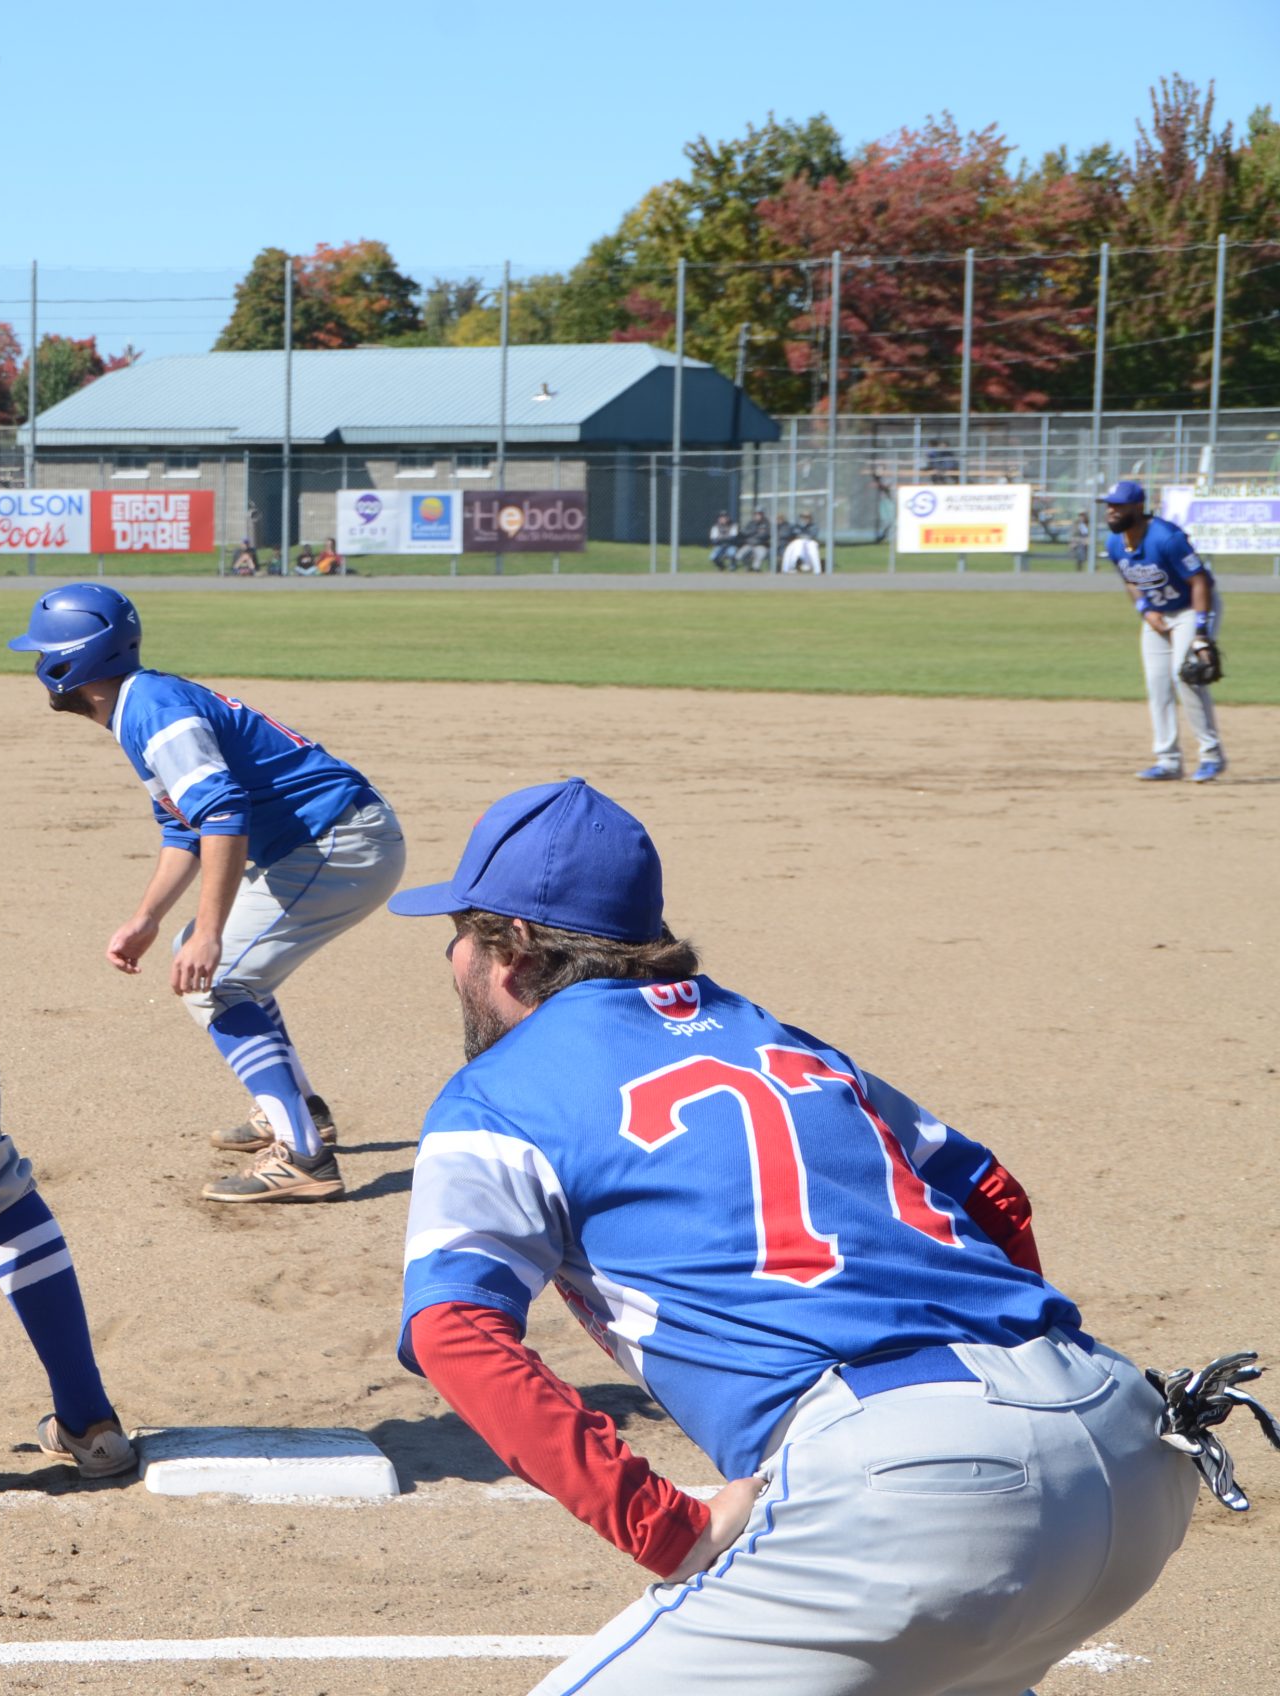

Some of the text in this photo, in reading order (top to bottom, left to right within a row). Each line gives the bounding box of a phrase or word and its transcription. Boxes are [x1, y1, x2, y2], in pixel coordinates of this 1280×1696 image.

[113, 521, 190, 549] DIABLE
[1147, 585, 1181, 606] 24
[663, 1017, 724, 1037] Sport
[619, 1044, 965, 1288] 77
